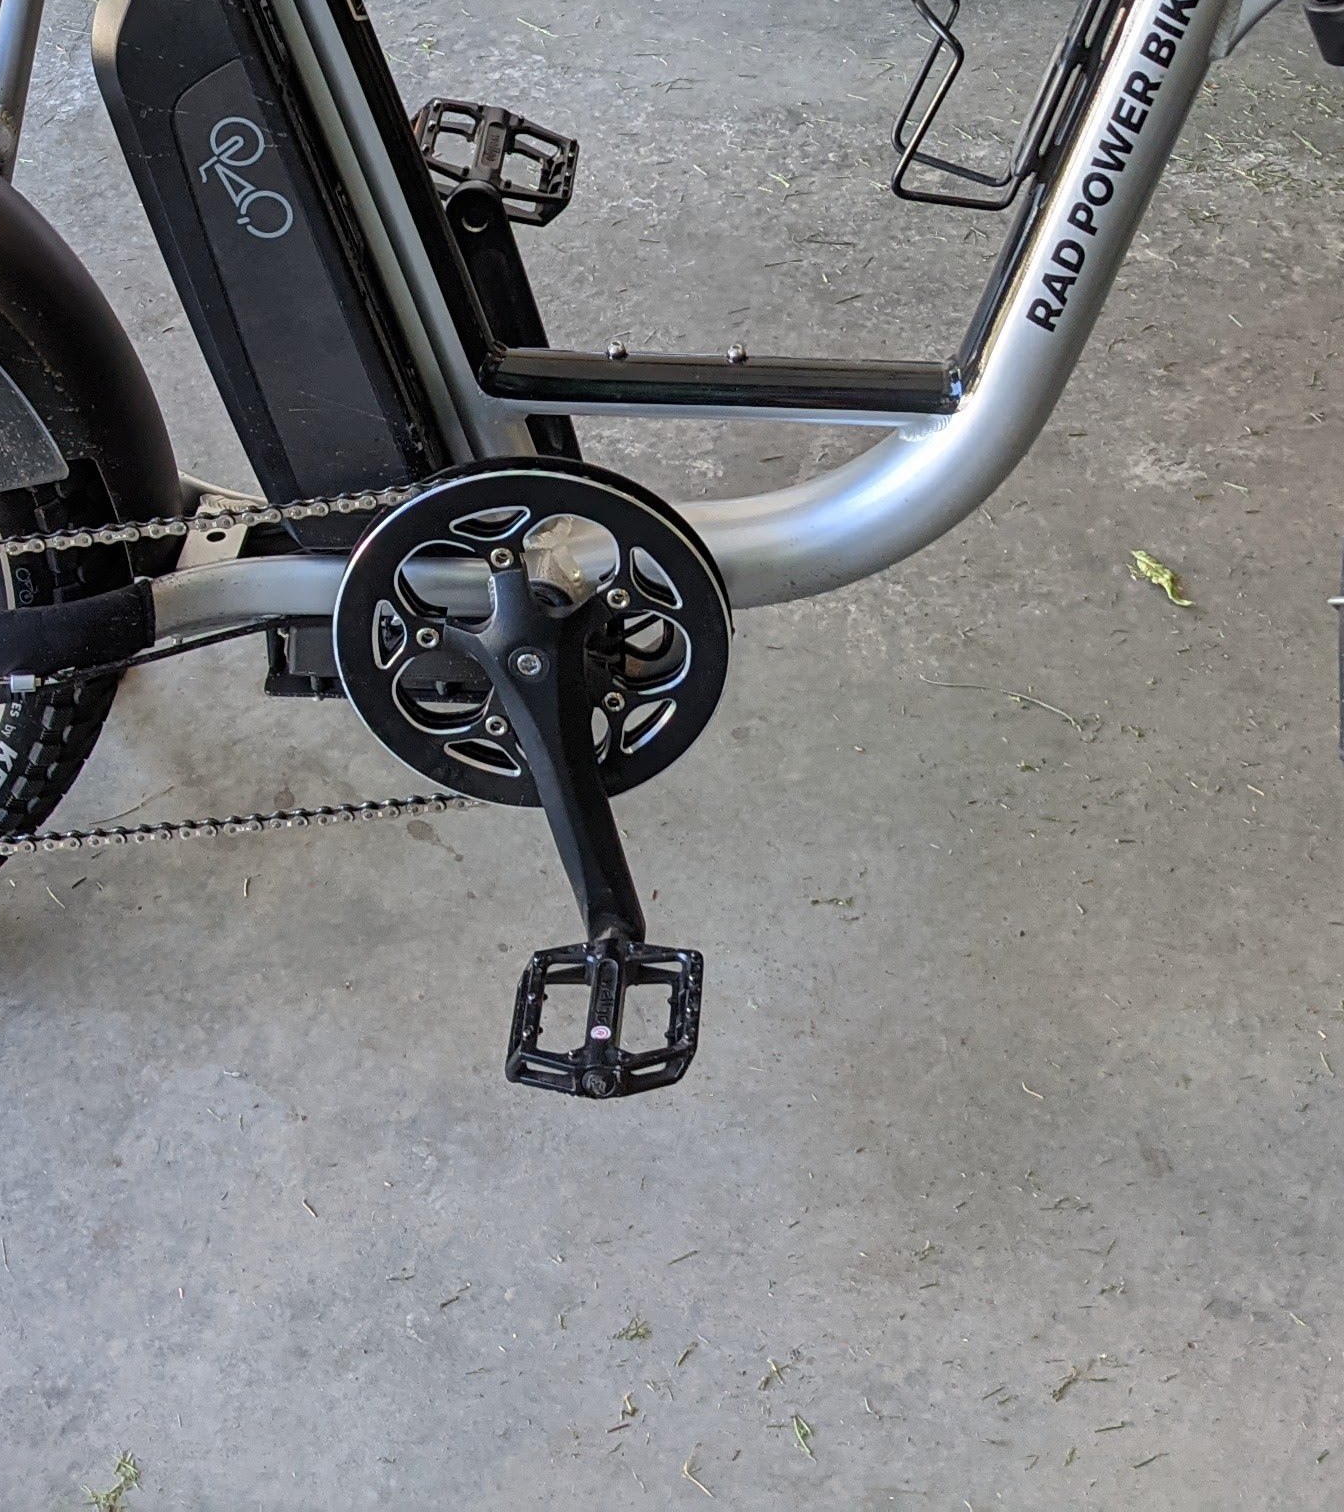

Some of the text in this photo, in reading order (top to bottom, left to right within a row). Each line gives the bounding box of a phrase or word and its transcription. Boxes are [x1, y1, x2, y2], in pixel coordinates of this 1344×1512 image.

[1025, 241, 1086, 334] RAD
[1074, 70, 1162, 237] POWER
[1, 723, 16, 738] by
